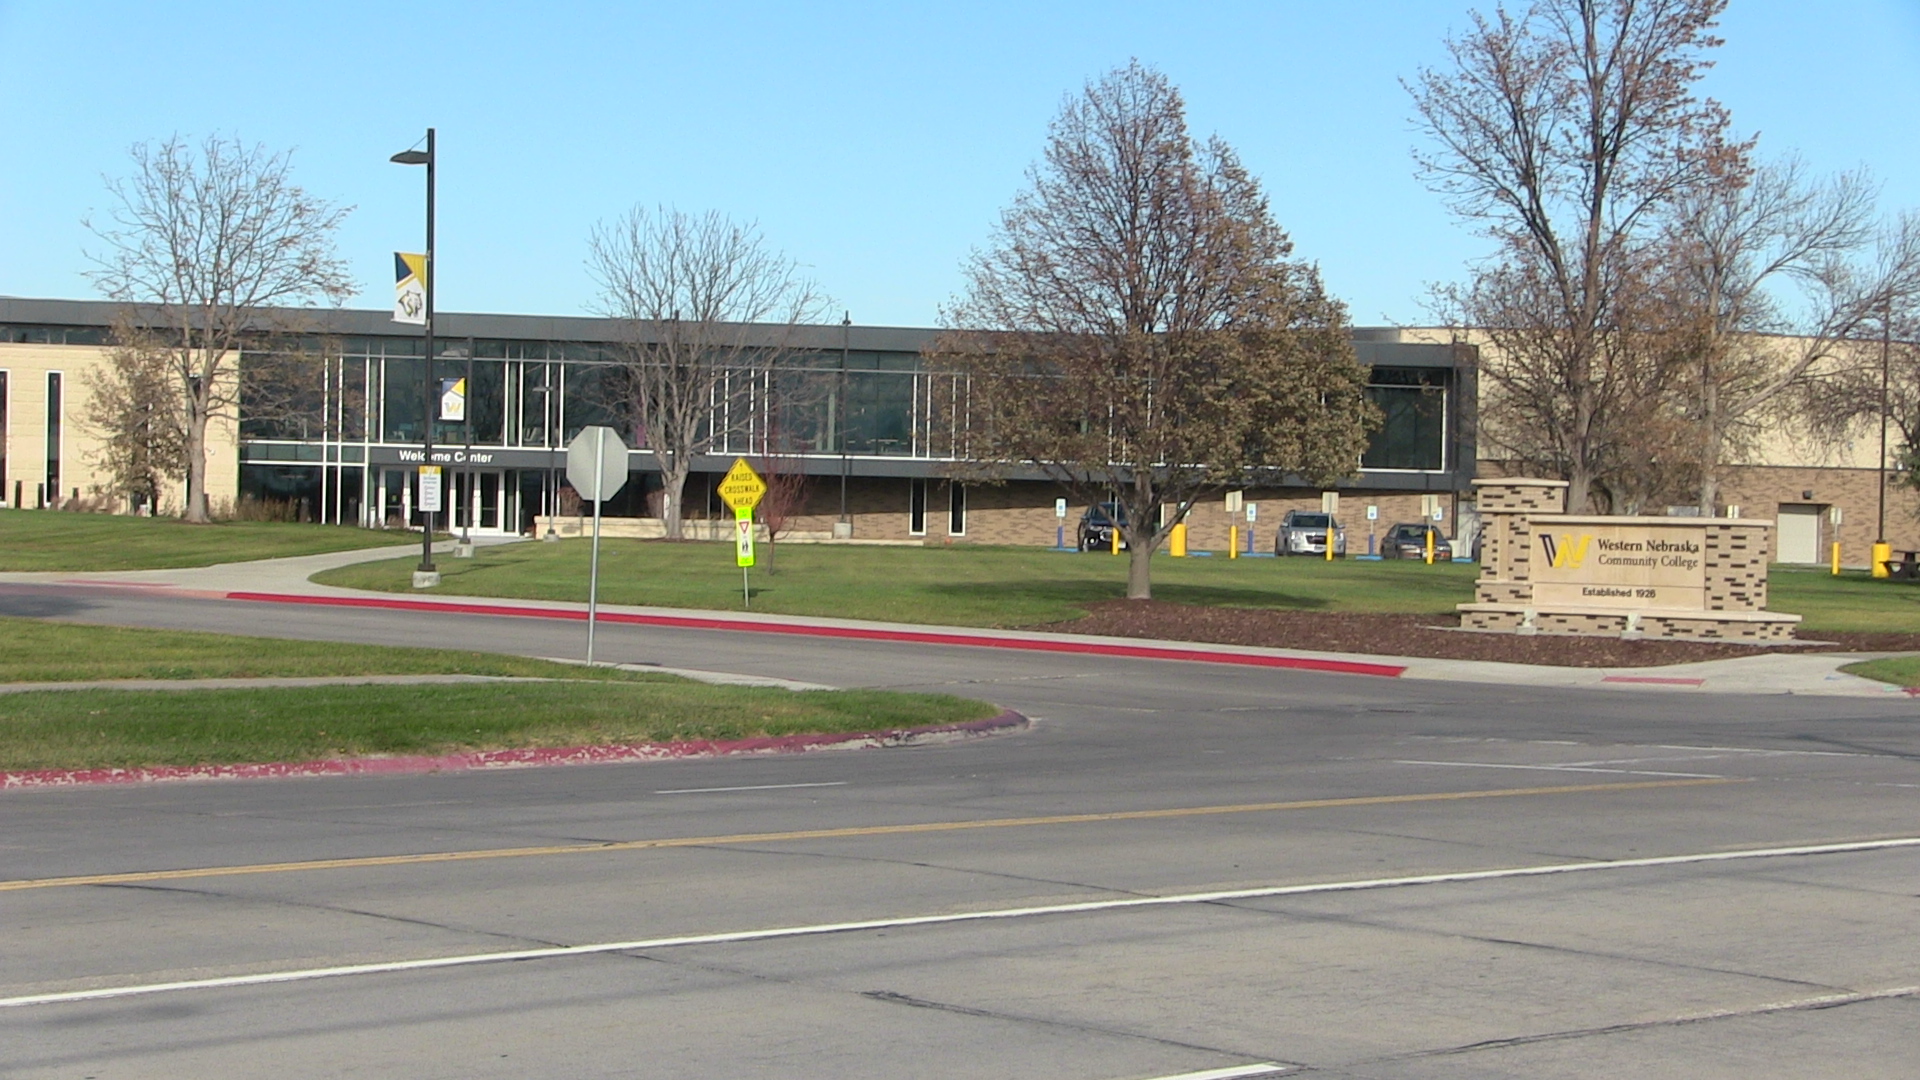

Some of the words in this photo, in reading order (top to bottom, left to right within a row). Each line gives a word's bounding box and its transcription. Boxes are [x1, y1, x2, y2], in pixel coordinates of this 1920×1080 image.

[731, 472, 753, 481] RAISED
[724, 484, 760, 494] CROSSWALK
[733, 496, 753, 505] AHEAD
[1598, 538, 1643, 552] Western
[1646, 539, 1700, 554] Nebraska
[1598, 554, 1659, 570] Community
[1660, 555, 1699, 571] College
[1582, 586, 1633, 598] Established
